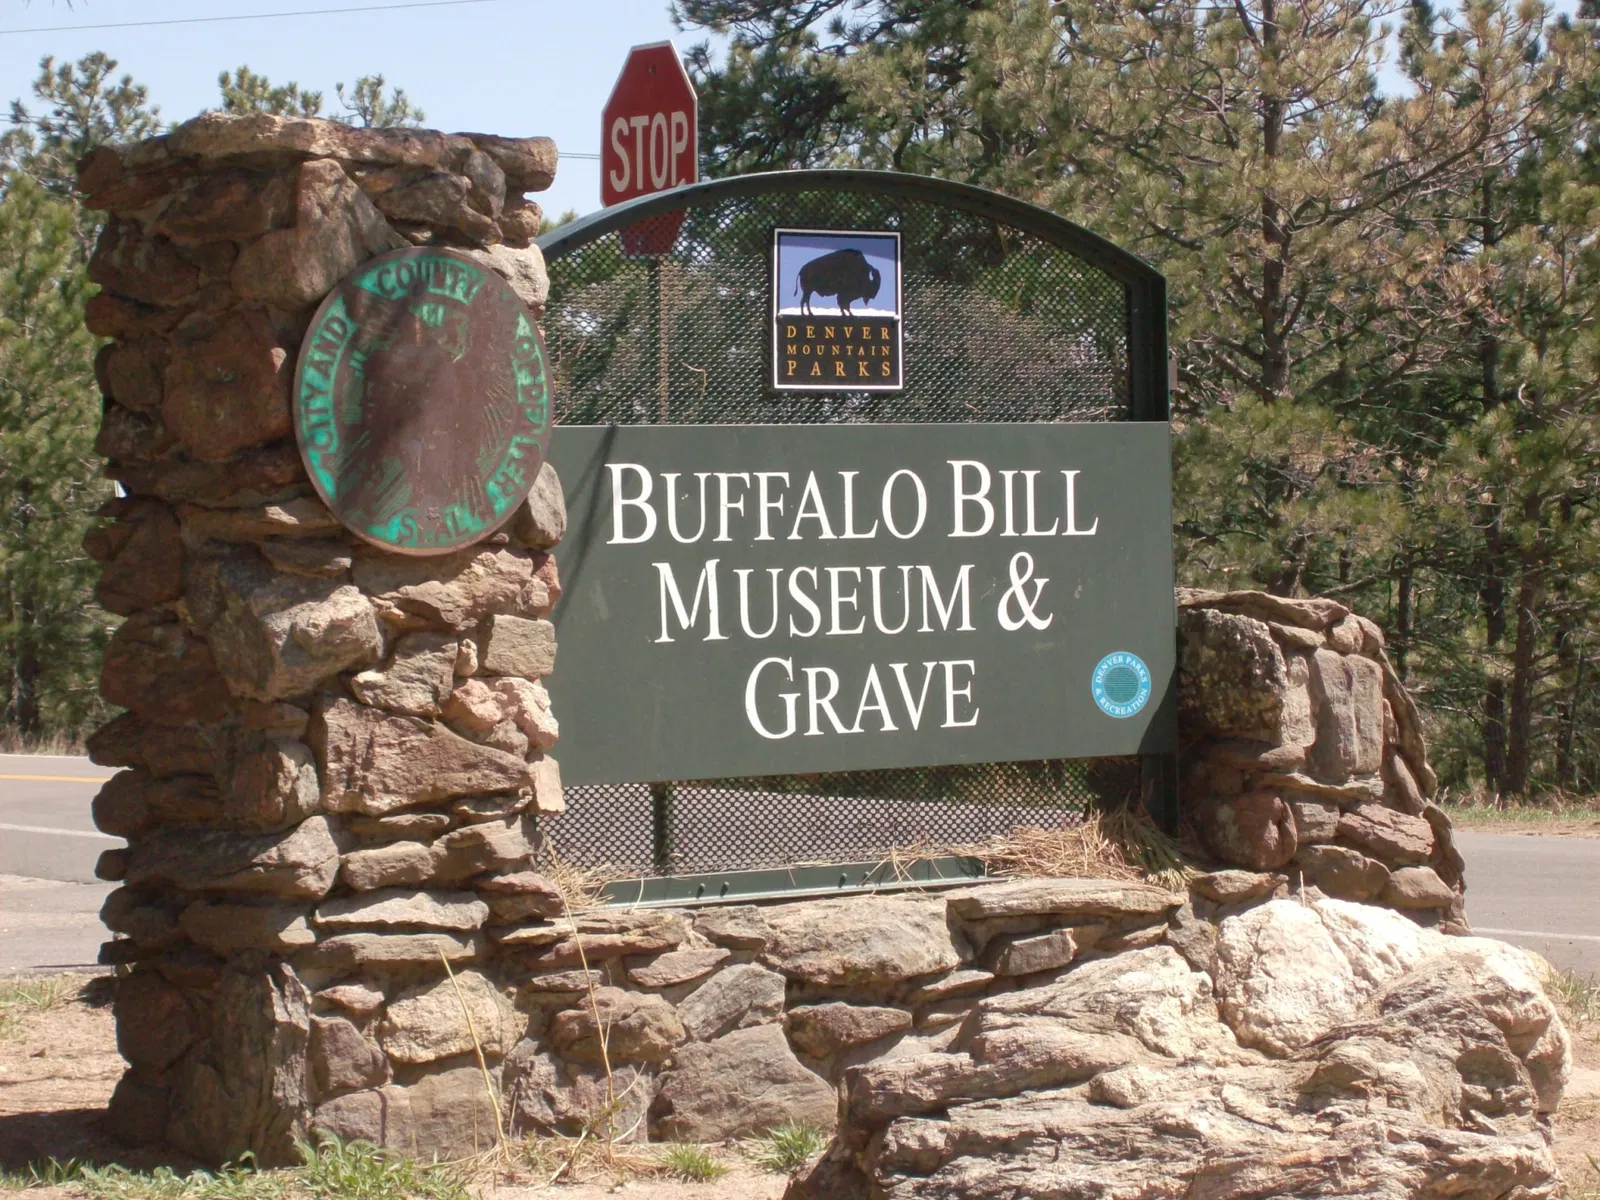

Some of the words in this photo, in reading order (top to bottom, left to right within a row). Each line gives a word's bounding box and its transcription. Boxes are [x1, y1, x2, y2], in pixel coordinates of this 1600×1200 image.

[610, 110, 689, 193] STOP
[312, 315, 349, 382] AND
[376, 259, 482, 300] COUNTY
[786, 324, 890, 340] DENVER
[786, 344, 890, 356] MOUNTAIN
[786, 360, 891, 377] PARKS
[605, 462, 928, 545] BUFFALO
[946, 459, 1099, 538] BILL
[651, 558, 976, 643] MUSEUM
[996, 551, 1054, 631] &
[744, 656, 980, 739] GRAVE
[1095, 655, 1124, 684] DENVER
[1125, 656, 1148, 683] PARKS
[1099, 687, 1148, 715] RECREATION
